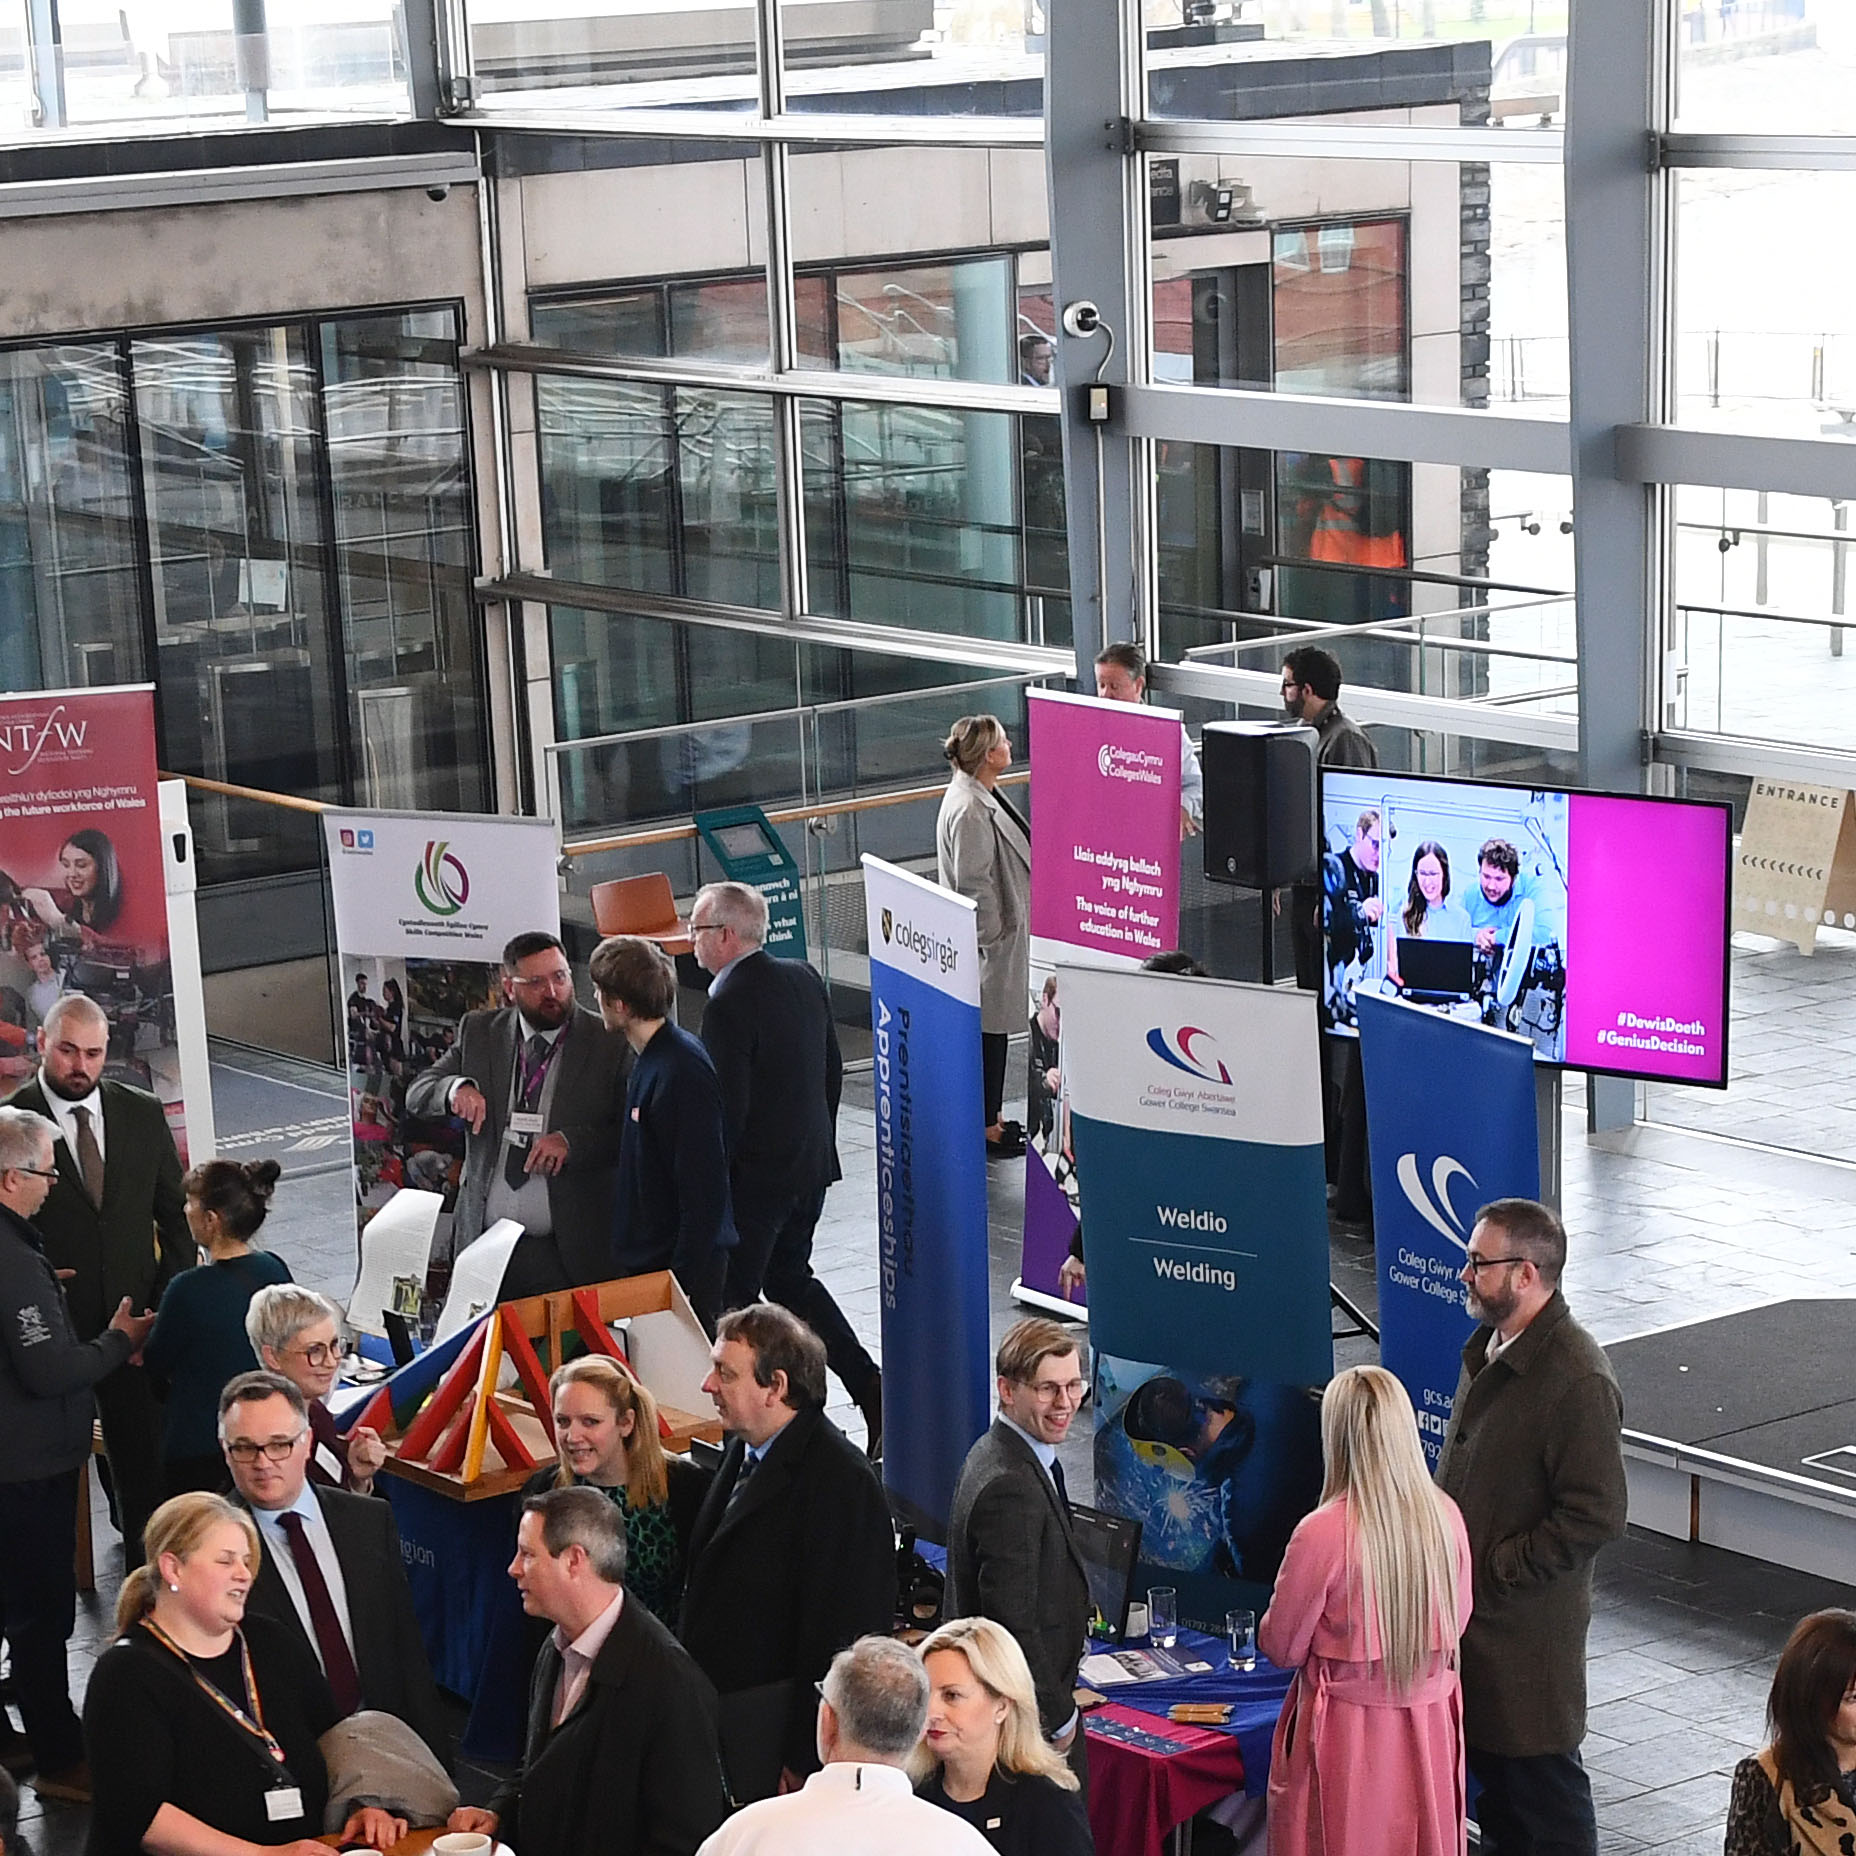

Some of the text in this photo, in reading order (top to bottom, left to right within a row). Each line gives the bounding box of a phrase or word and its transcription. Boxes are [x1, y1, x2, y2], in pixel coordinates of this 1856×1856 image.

[1756, 784, 1839, 808] ENTRANCE
[5, 805, 20, 818] the
[1074, 845, 1162, 876] Llais addysg bellach
[1102, 875, 1163, 898] yng Nghymru
[1076, 896, 1160, 928] The voice of further
[1080, 919, 1162, 949] education in Wales
[1617, 1012, 1705, 1036] #DewisDoeth
[1597, 1030, 1705, 1055] #GeniusDecision
[1139, 1097, 1166, 1109] Gower
[1168, 1100, 1200, 1113] College
[876, 998, 897, 1311] Apprenticeships
[1157, 1206, 1227, 1233] Weldio
[1153, 1257, 1236, 1291] Welding
[1398, 1248, 1426, 1274] Coleg
[1389, 1266, 1420, 1289] Gower
[1422, 1277, 1458, 1304] College
